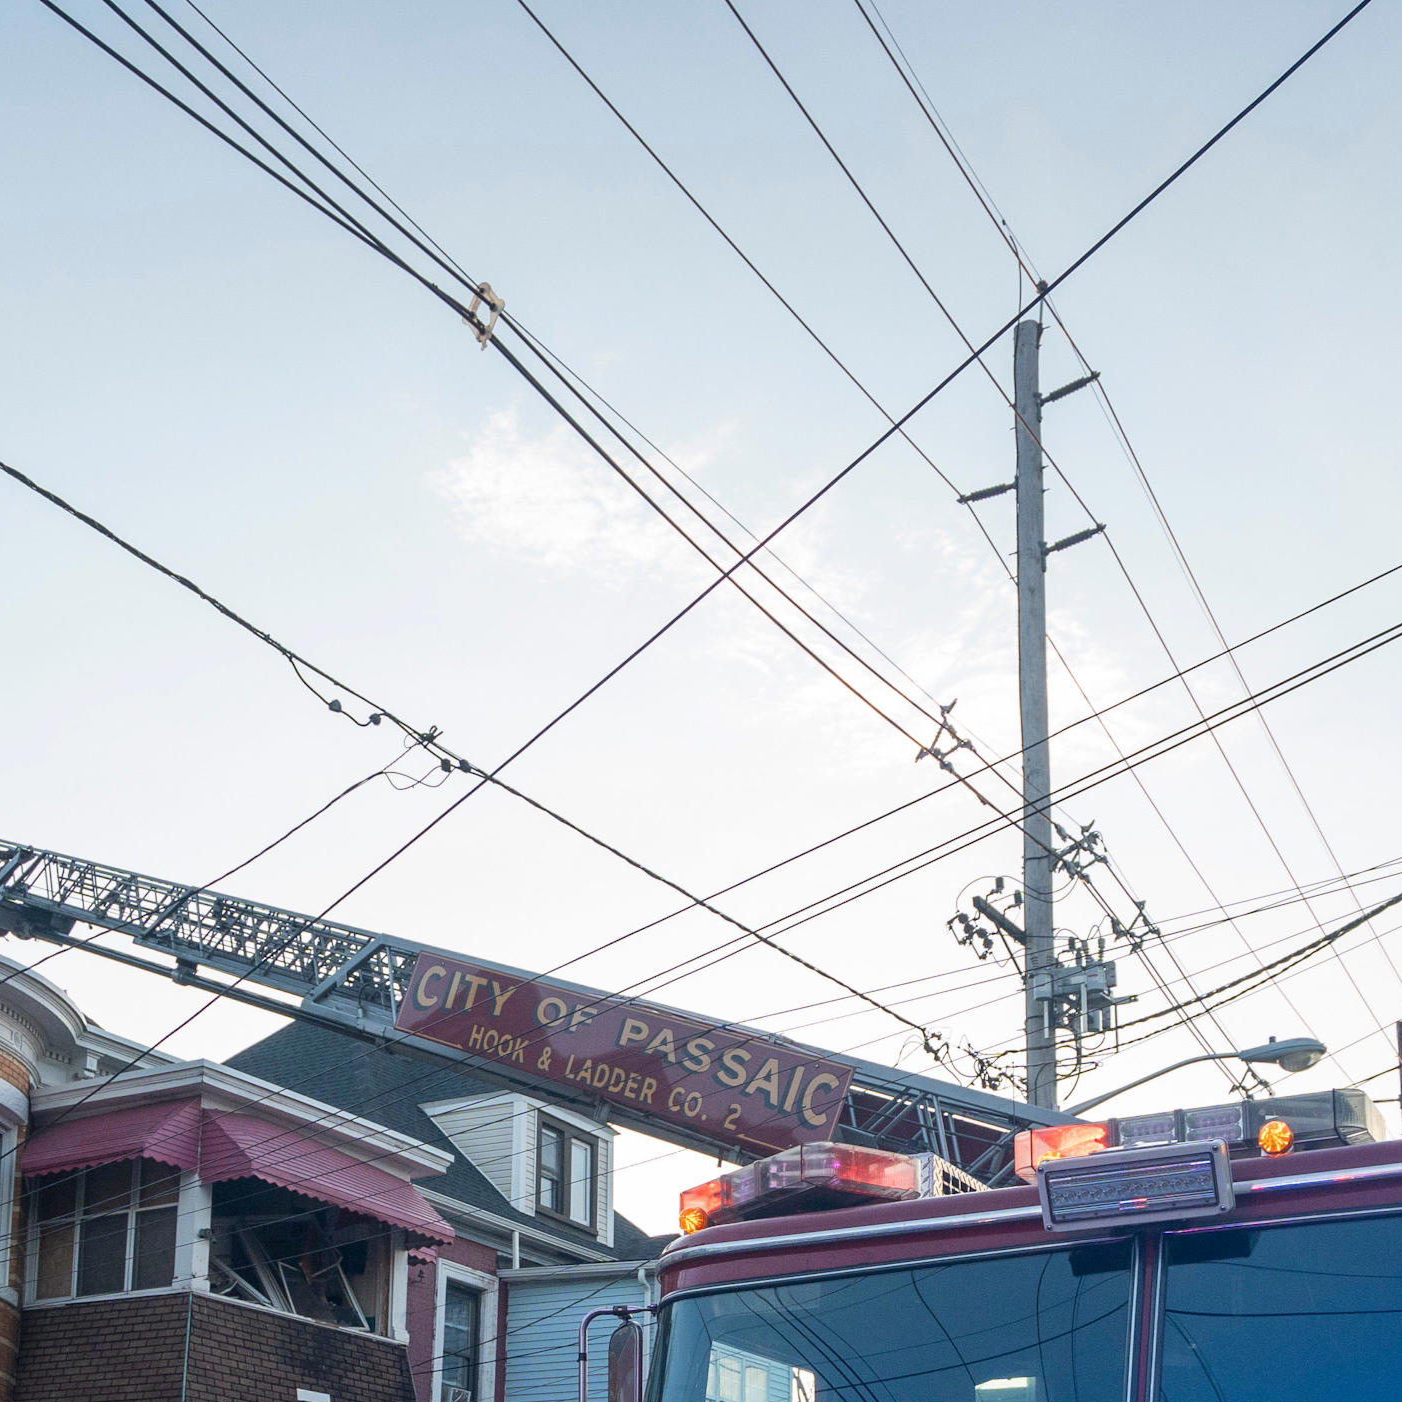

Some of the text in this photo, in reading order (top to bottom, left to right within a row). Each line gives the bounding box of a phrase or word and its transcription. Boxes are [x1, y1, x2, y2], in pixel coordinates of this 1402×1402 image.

[414, 964, 841, 1128] CITY OF PASSAIC
[468, 1024, 743, 1131] HOOK & LADDER CO. 2
